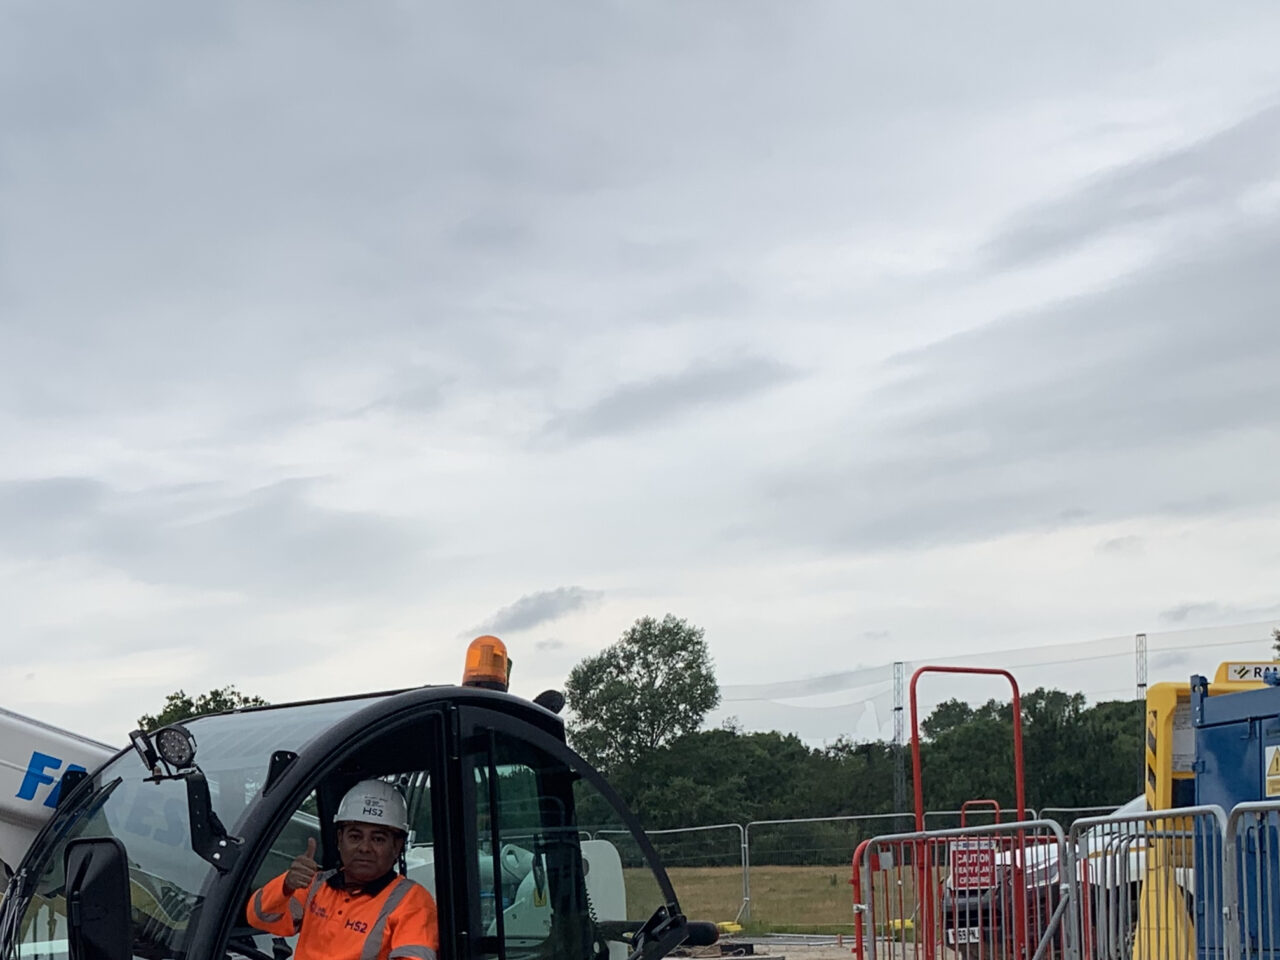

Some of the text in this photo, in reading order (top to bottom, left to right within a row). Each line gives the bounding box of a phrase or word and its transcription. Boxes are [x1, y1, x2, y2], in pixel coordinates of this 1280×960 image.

[363, 807, 383, 817] HS2
[956, 853, 991, 863] CAUTON
[345, 918, 368, 934] HS2
